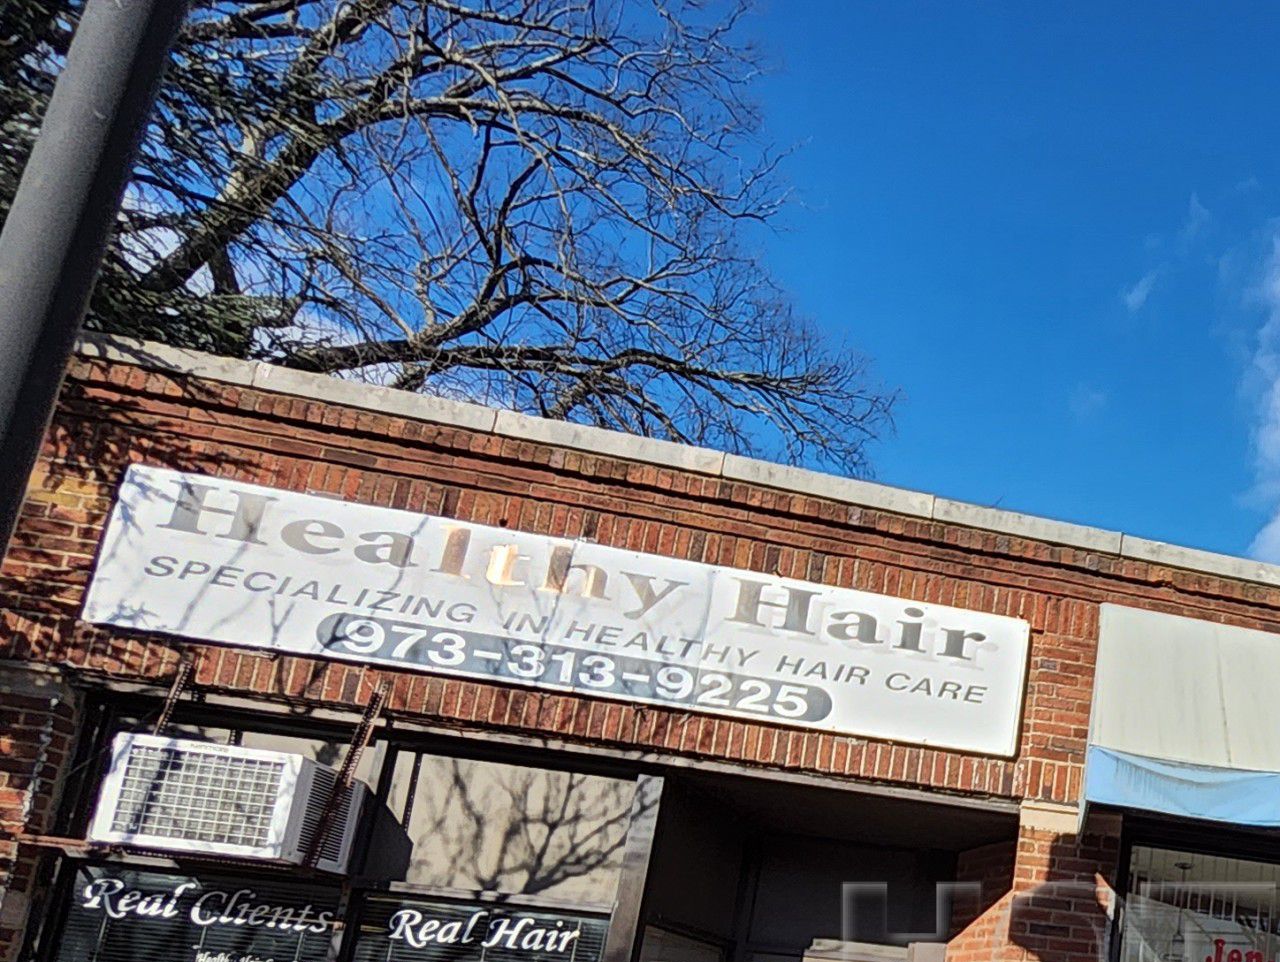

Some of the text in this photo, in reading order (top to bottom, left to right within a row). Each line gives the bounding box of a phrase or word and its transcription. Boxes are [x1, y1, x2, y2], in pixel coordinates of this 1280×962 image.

[156, 481, 988, 662] Healthy Hair
[144, 556, 988, 704] SPECIALIZING IN HEALTHY HAIR CARE
[345, 619, 809, 719] 973-313-9225
[83, 878, 333, 933] Real Clients
[388, 909, 580, 952] Real Hair
